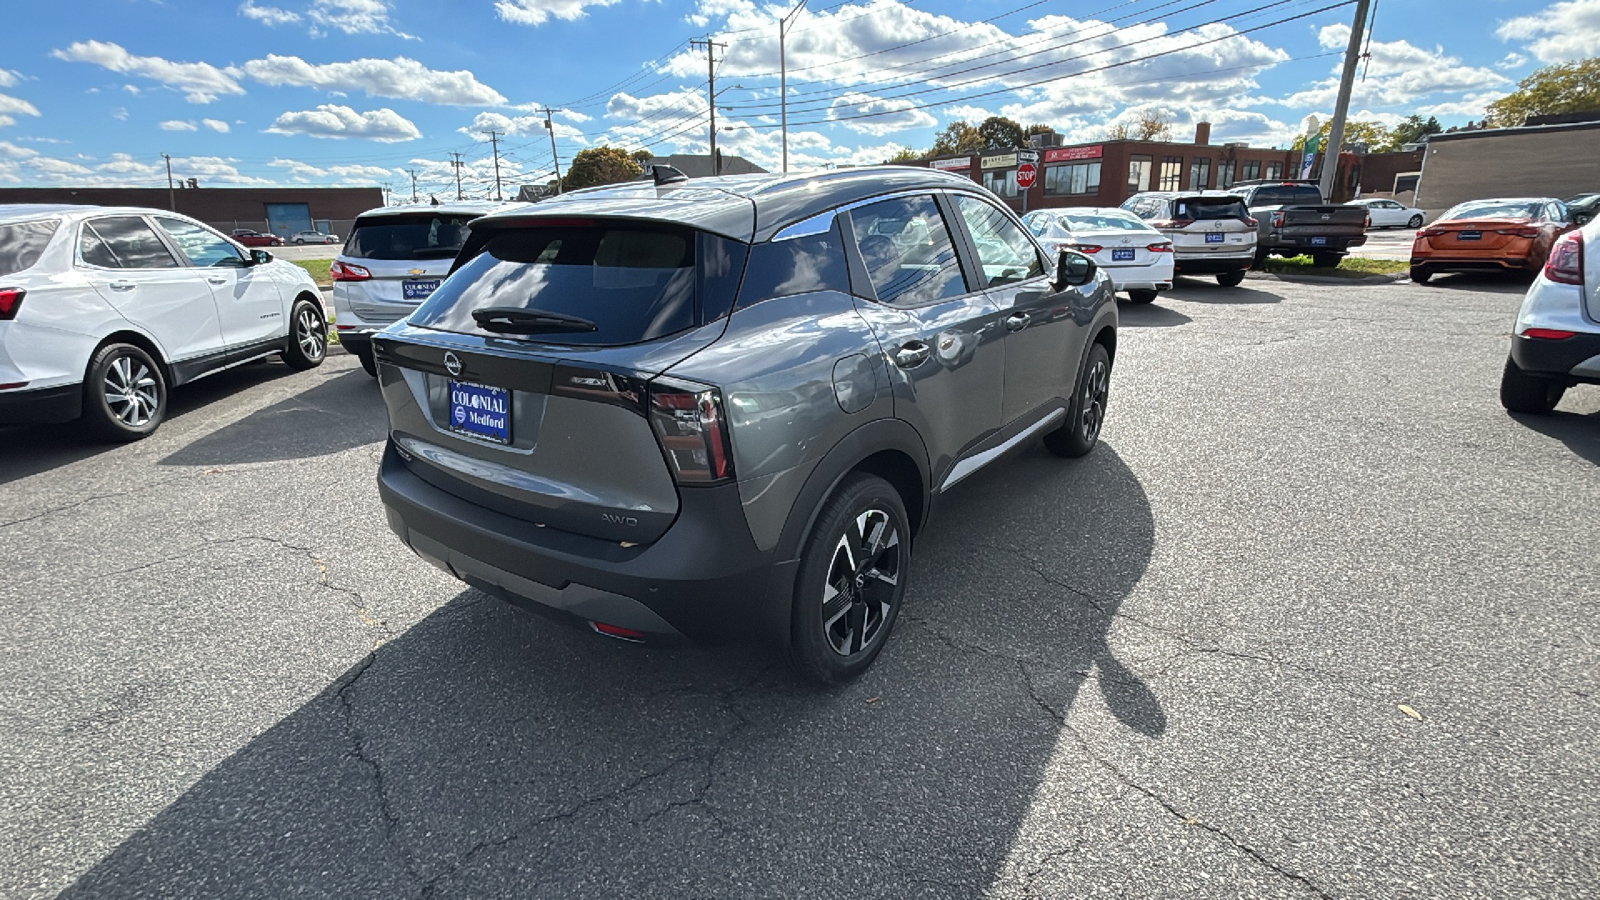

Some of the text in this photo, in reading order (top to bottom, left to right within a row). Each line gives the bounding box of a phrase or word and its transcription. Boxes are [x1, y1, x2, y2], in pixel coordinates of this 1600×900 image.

[1017, 171, 1035, 181] STOP
[452, 390, 507, 414] COLONIAL
[469, 411, 504, 429] Medford
[601, 512, 638, 527] AWD
